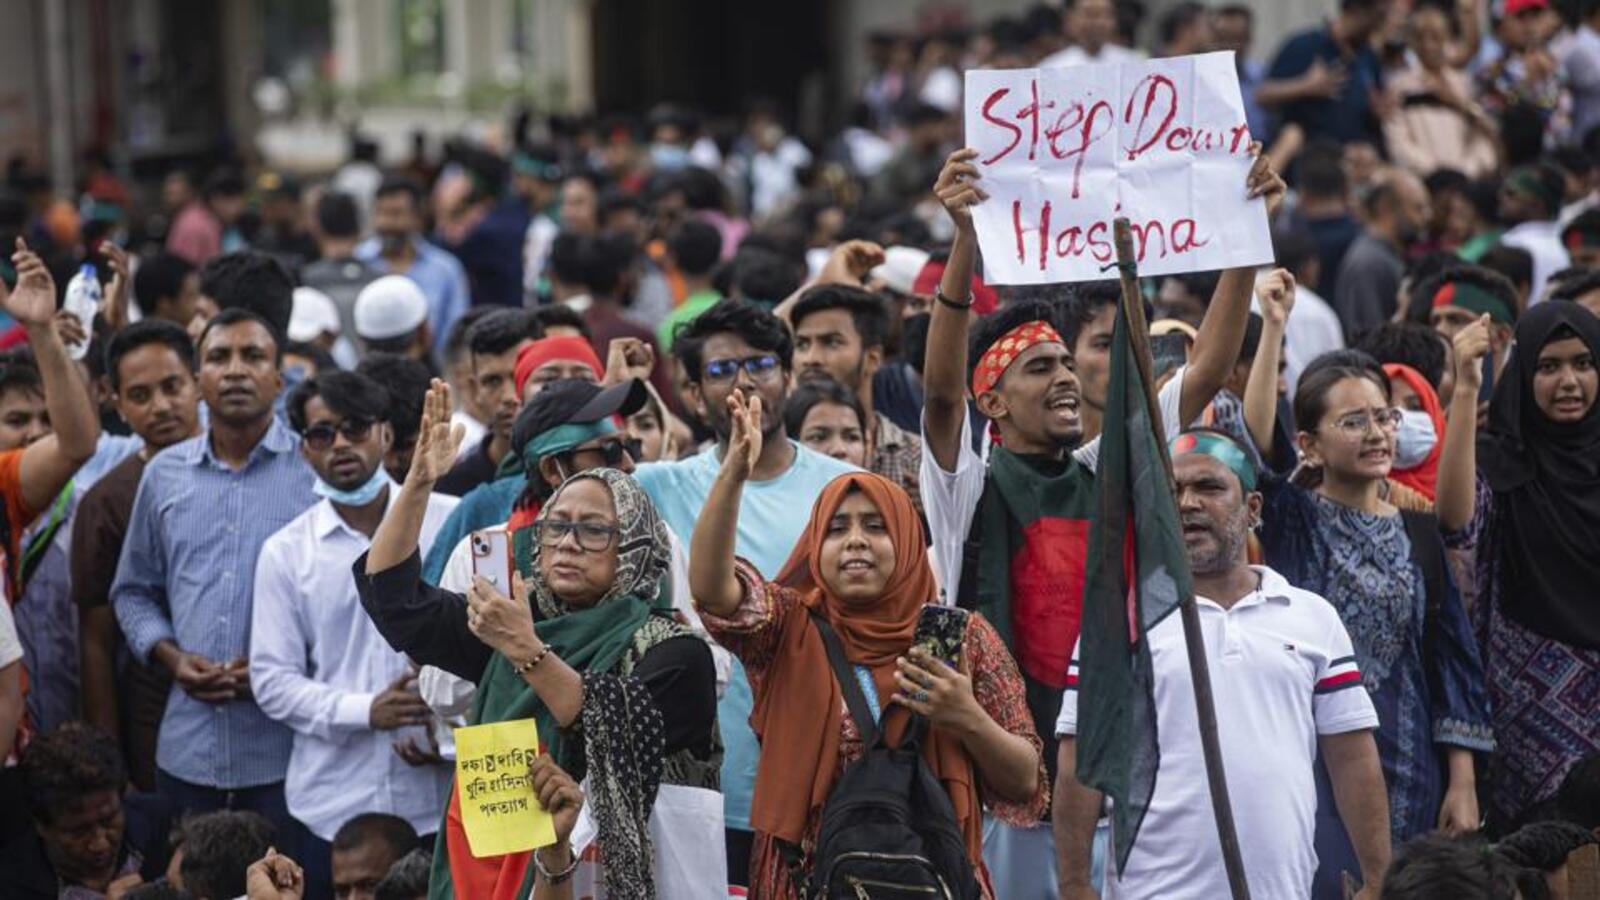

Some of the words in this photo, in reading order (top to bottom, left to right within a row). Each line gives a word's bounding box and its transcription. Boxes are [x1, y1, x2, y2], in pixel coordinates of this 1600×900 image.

[982, 79, 1113, 198] Step
[1124, 74, 1251, 160] Down
[1013, 200, 1208, 270] Hasna
